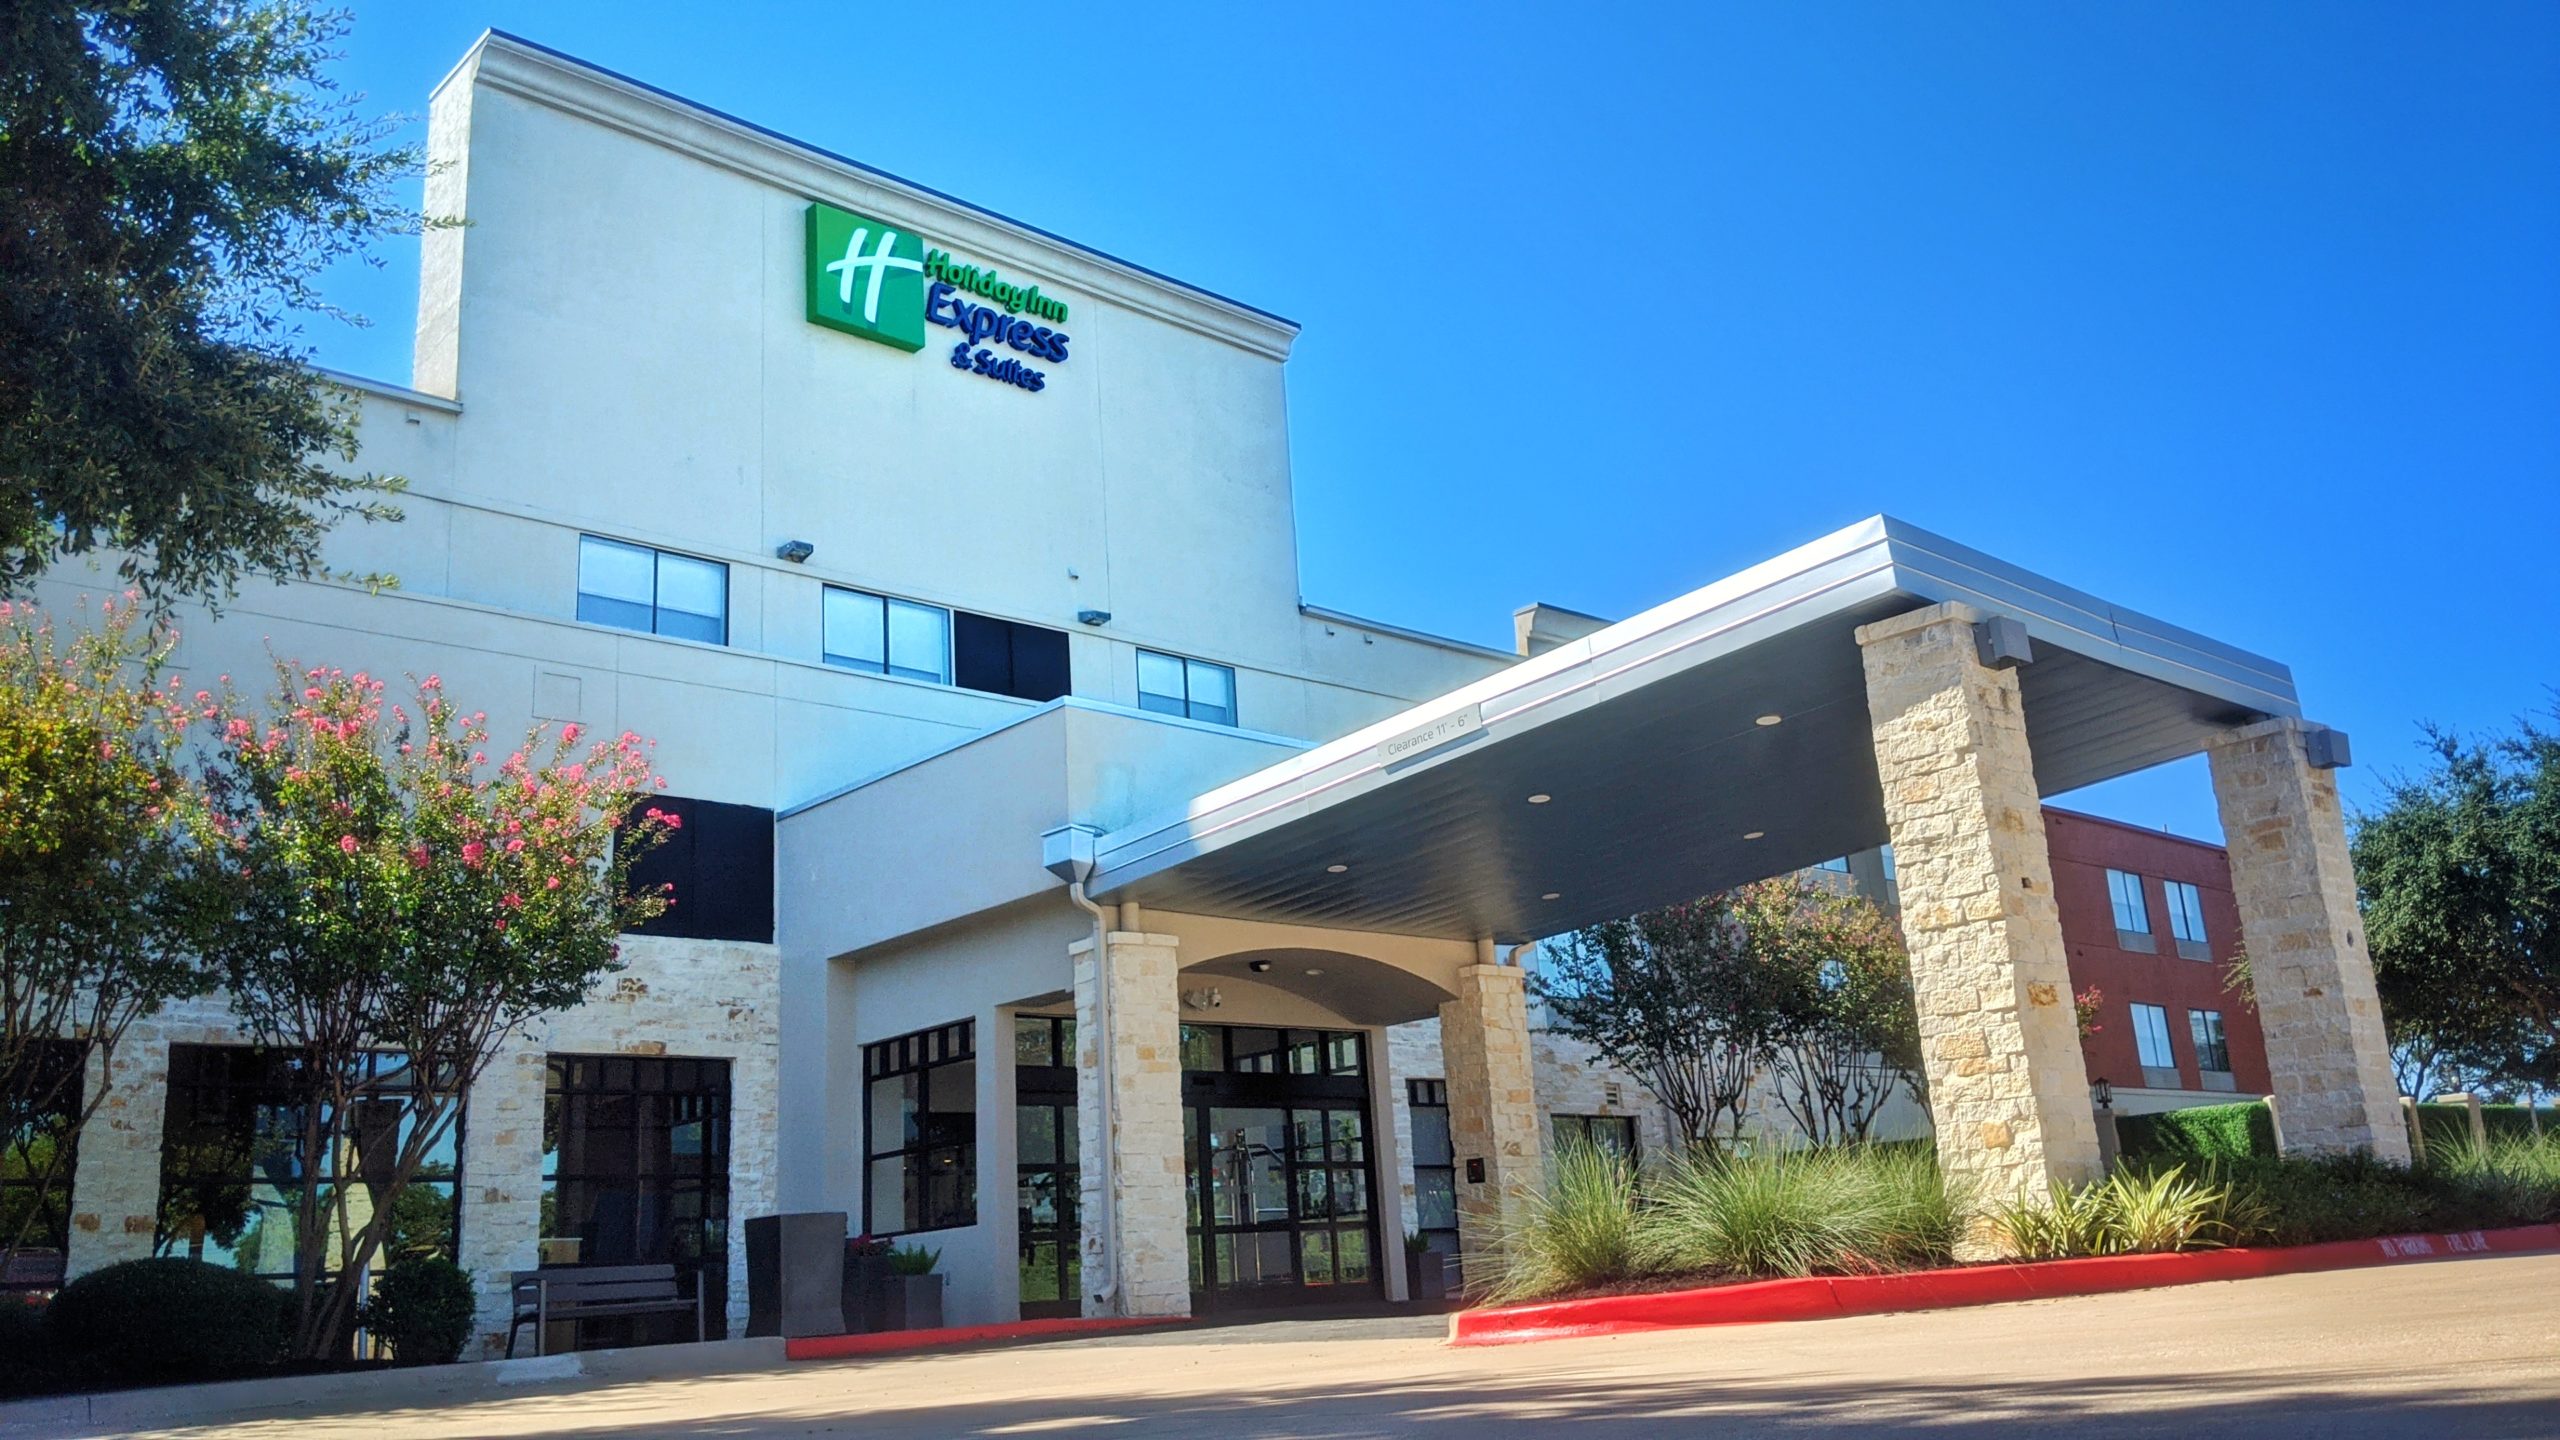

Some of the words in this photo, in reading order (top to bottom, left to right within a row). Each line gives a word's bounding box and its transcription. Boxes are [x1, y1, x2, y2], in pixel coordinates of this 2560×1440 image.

[925, 282, 1070, 363] Express
[951, 342, 973, 369] &
[973, 349, 1045, 392] Suites
[1387, 731, 1434, 756] Clearance
